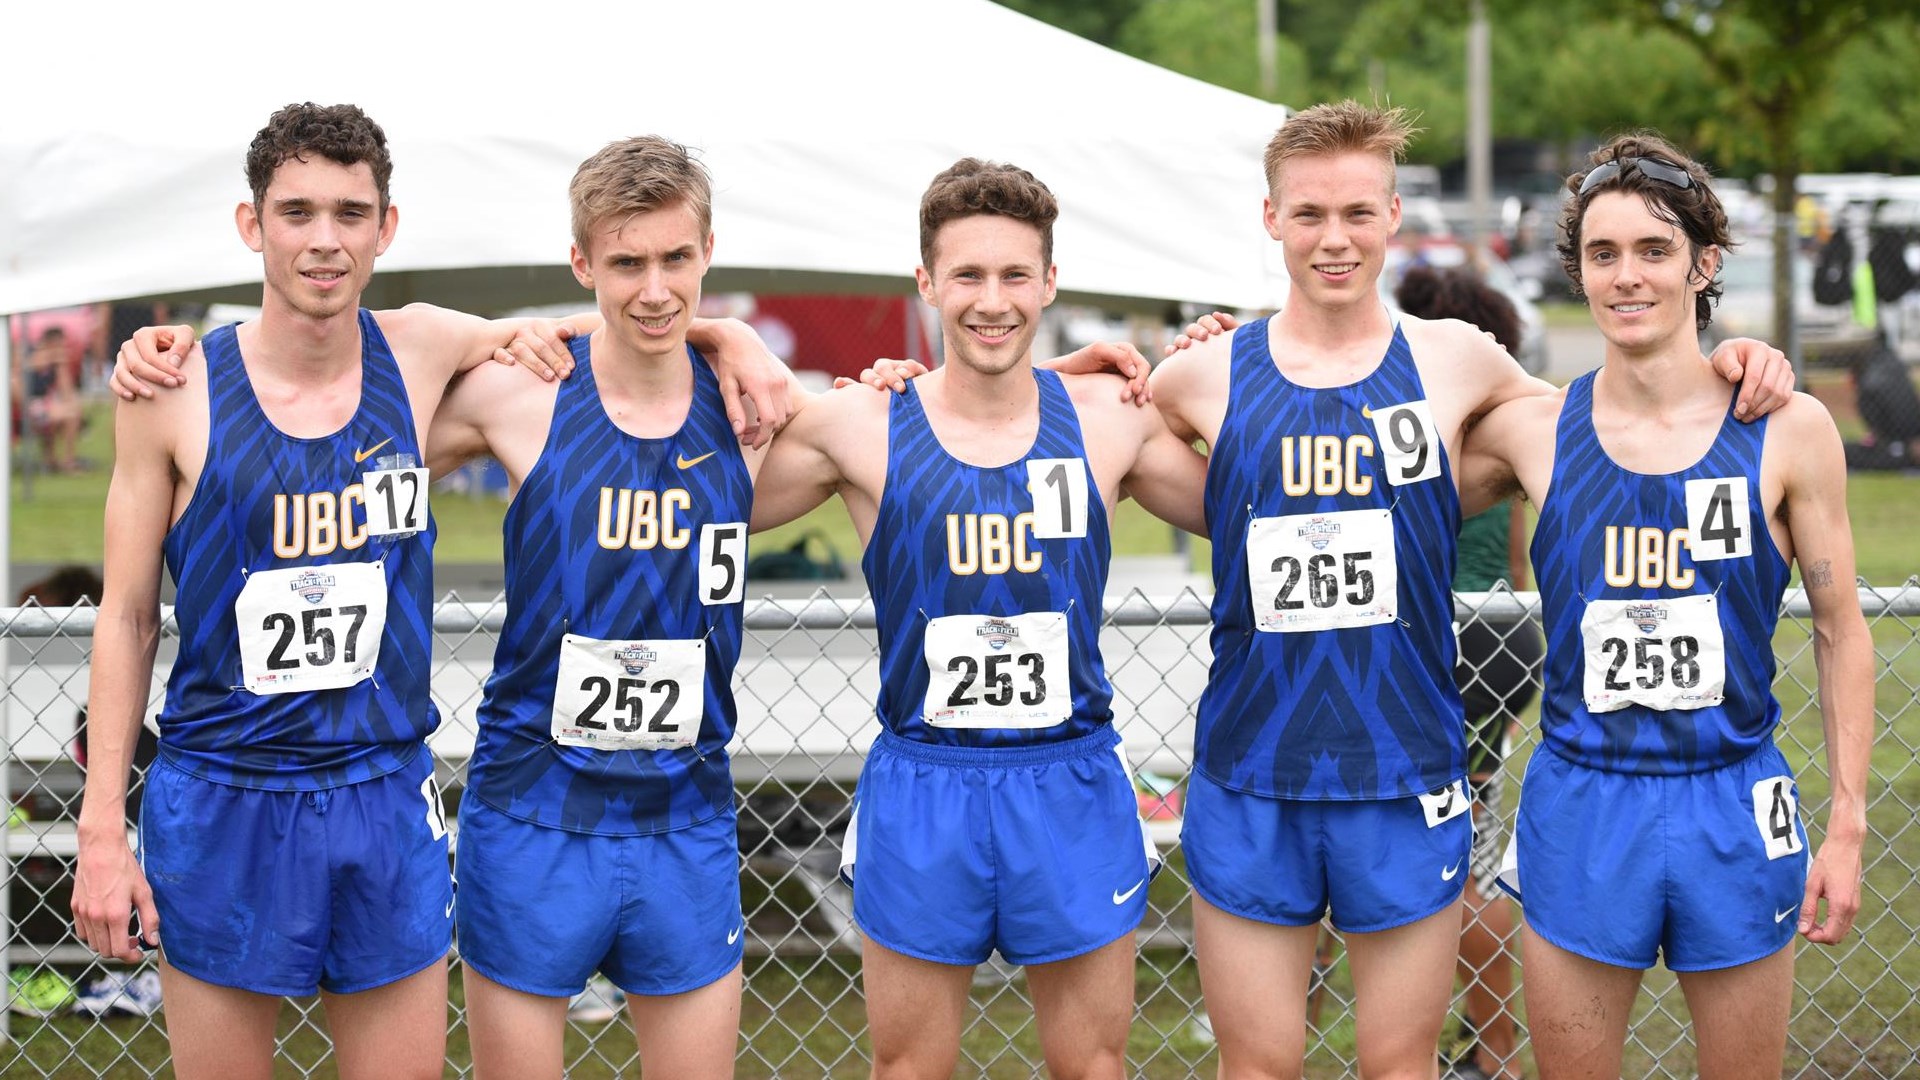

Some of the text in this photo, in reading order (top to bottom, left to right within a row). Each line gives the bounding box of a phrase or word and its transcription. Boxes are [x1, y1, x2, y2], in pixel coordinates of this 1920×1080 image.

[1282, 434, 1374, 497] UBC
[1389, 408, 1428, 479] 9
[273, 483, 368, 559] UBC
[375, 471, 418, 530] 12
[597, 486, 691, 550] UBC
[1044, 464, 1072, 532] 1
[1700, 483, 1742, 554] 4
[709, 528, 738, 600] 5
[946, 511, 1043, 576] UBC
[1604, 525, 1696, 590] UBC
[1270, 551, 1375, 610] 265
[262, 604, 367, 671] 257
[1601, 635, 1701, 691] 258
[575, 676, 680, 733] 252
[947, 652, 1047, 707] 253
[1769, 781, 1793, 849] 4
